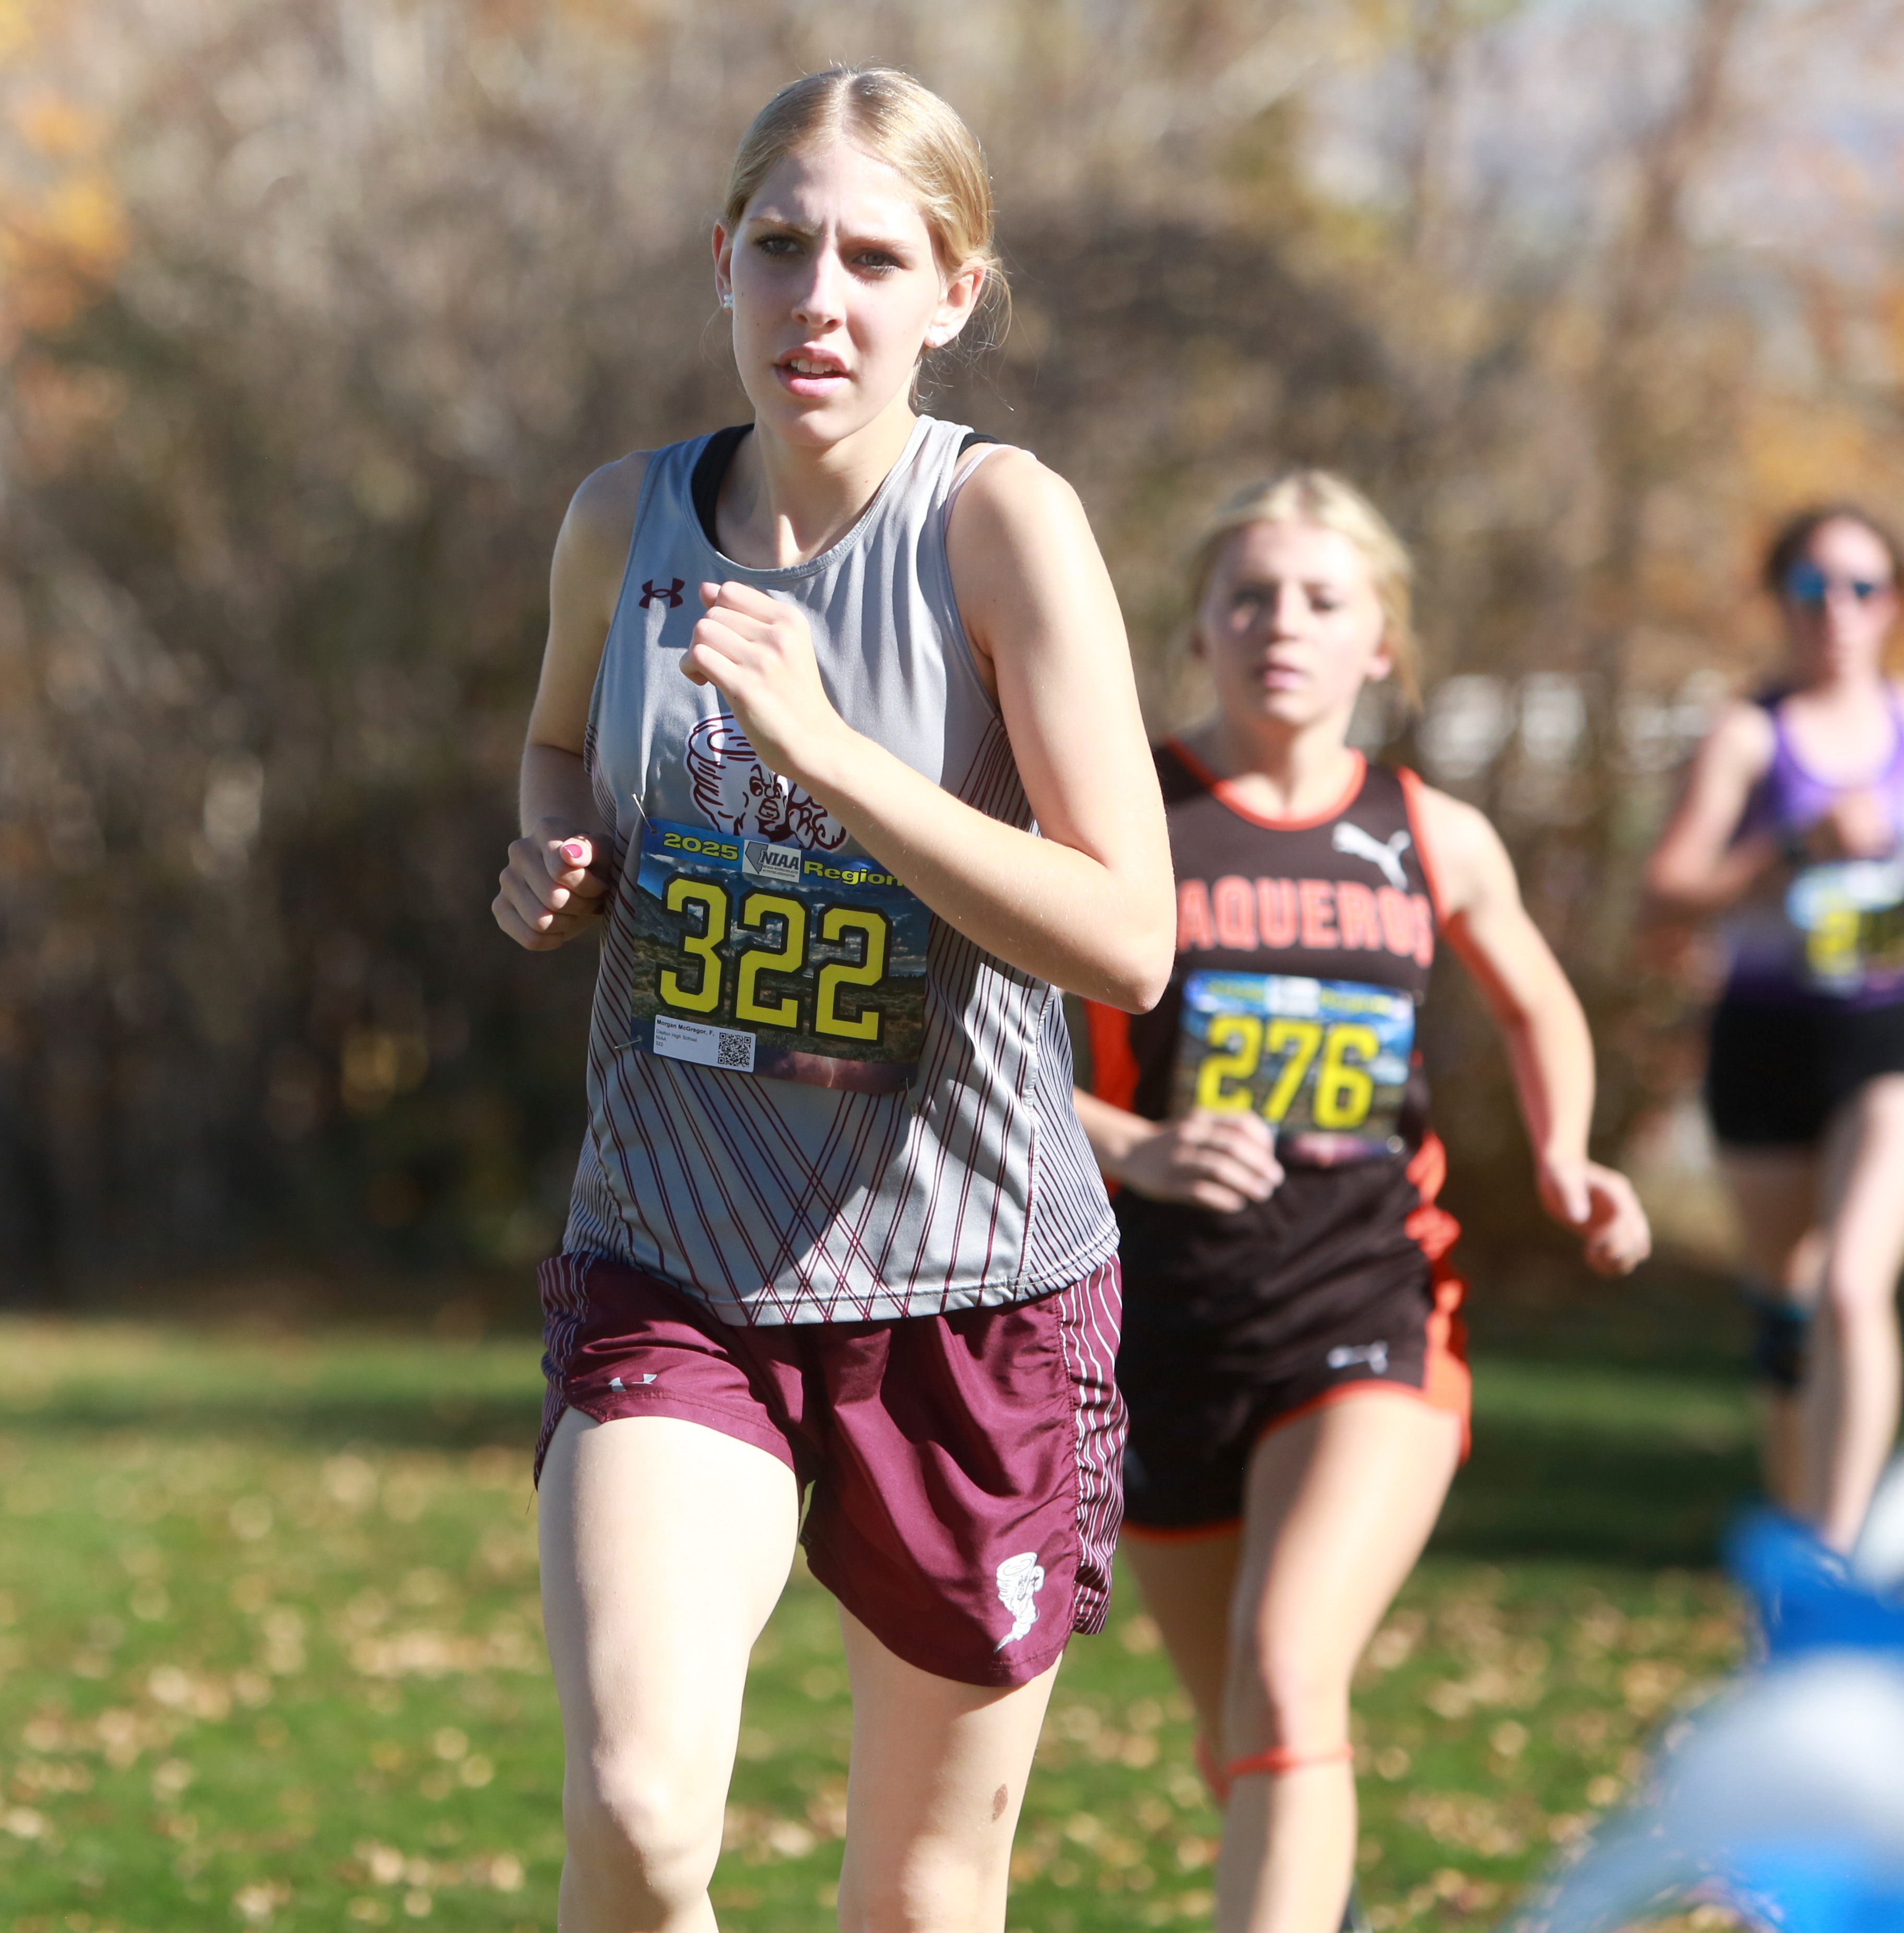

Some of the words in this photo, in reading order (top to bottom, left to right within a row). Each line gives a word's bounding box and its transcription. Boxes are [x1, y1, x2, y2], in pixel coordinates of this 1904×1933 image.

[663, 832, 739, 860] 2025
[760, 850, 799, 870] NIAA
[803, 860, 904, 886] Region
[658, 876, 889, 1043] 322
[657, 1019, 677, 1028] Morgan
[678, 1024, 708, 1035] McGregor,
[1196, 1016, 1379, 1129] 276
